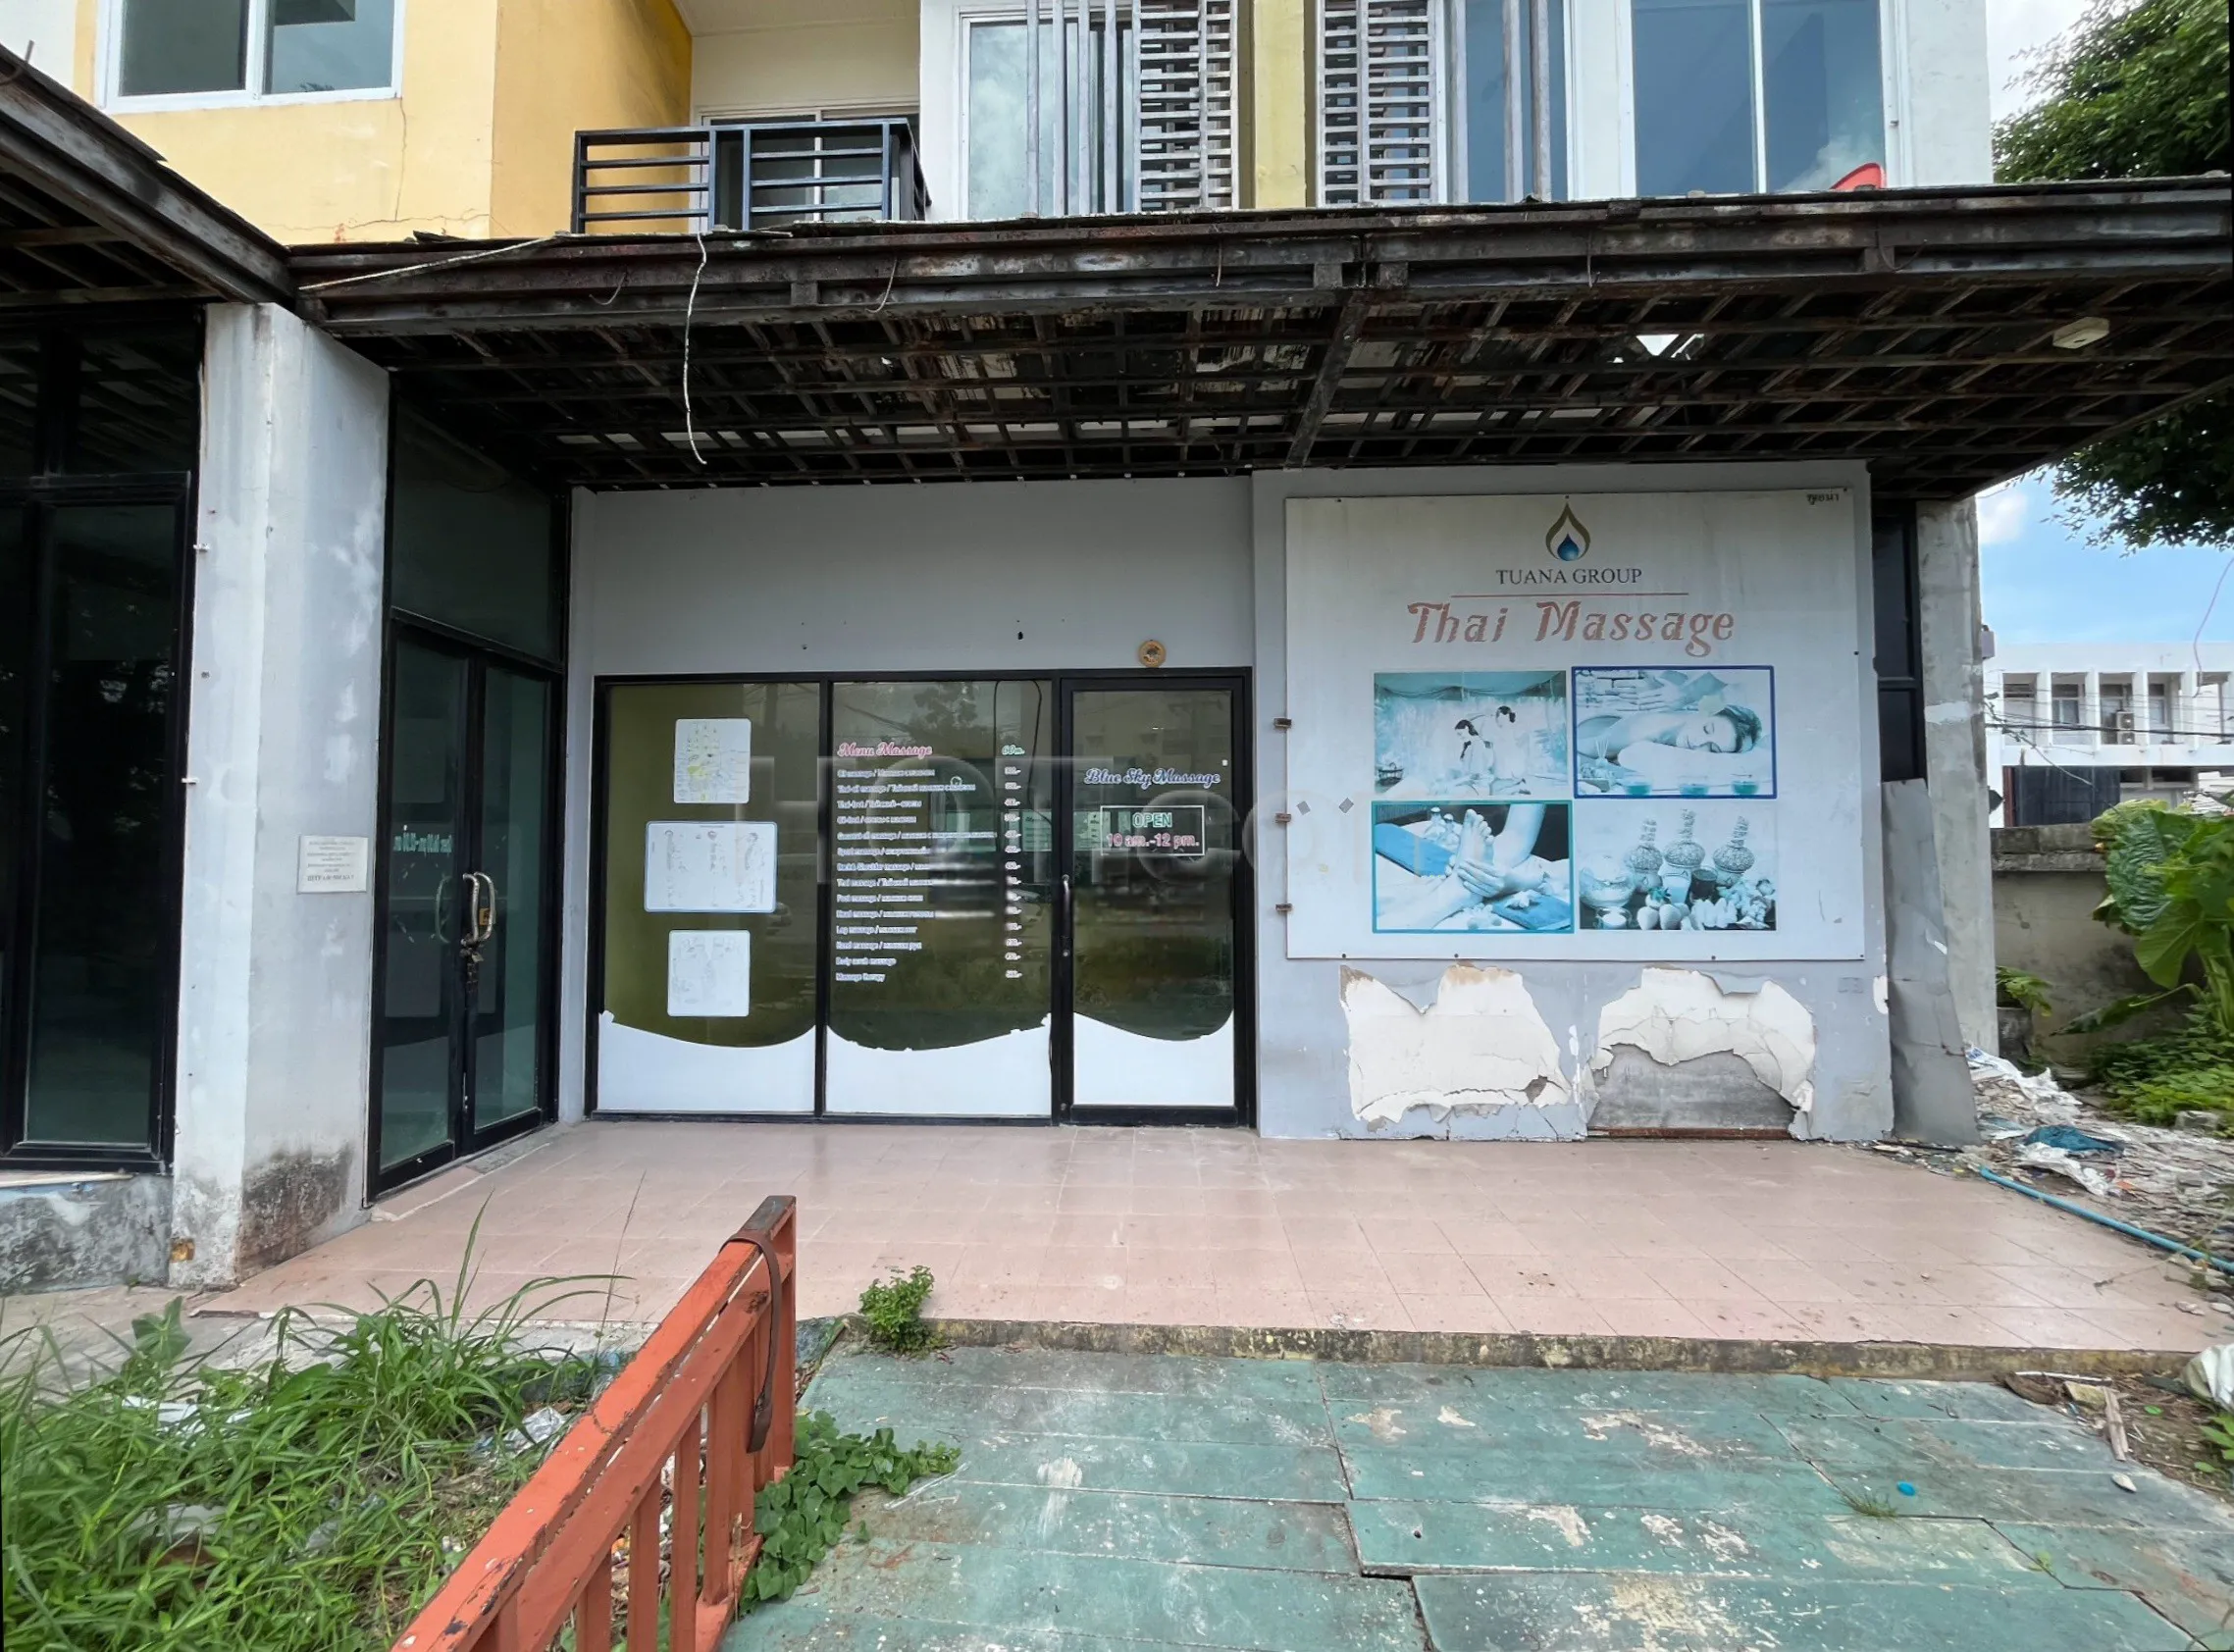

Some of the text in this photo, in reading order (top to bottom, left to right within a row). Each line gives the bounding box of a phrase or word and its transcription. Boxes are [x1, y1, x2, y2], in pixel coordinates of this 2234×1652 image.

[1496, 568, 1643, 586] TUANA GROUP
[1407, 598, 1736, 657] Thai Massage
[837, 742, 933, 759] Menu Massage
[1084, 768, 1221, 790] Blue Sky Massage
[1132, 812, 1172, 828] OPEN
[1107, 833, 1123, 848] 10
[1173, 834, 1200, 850] pm.
